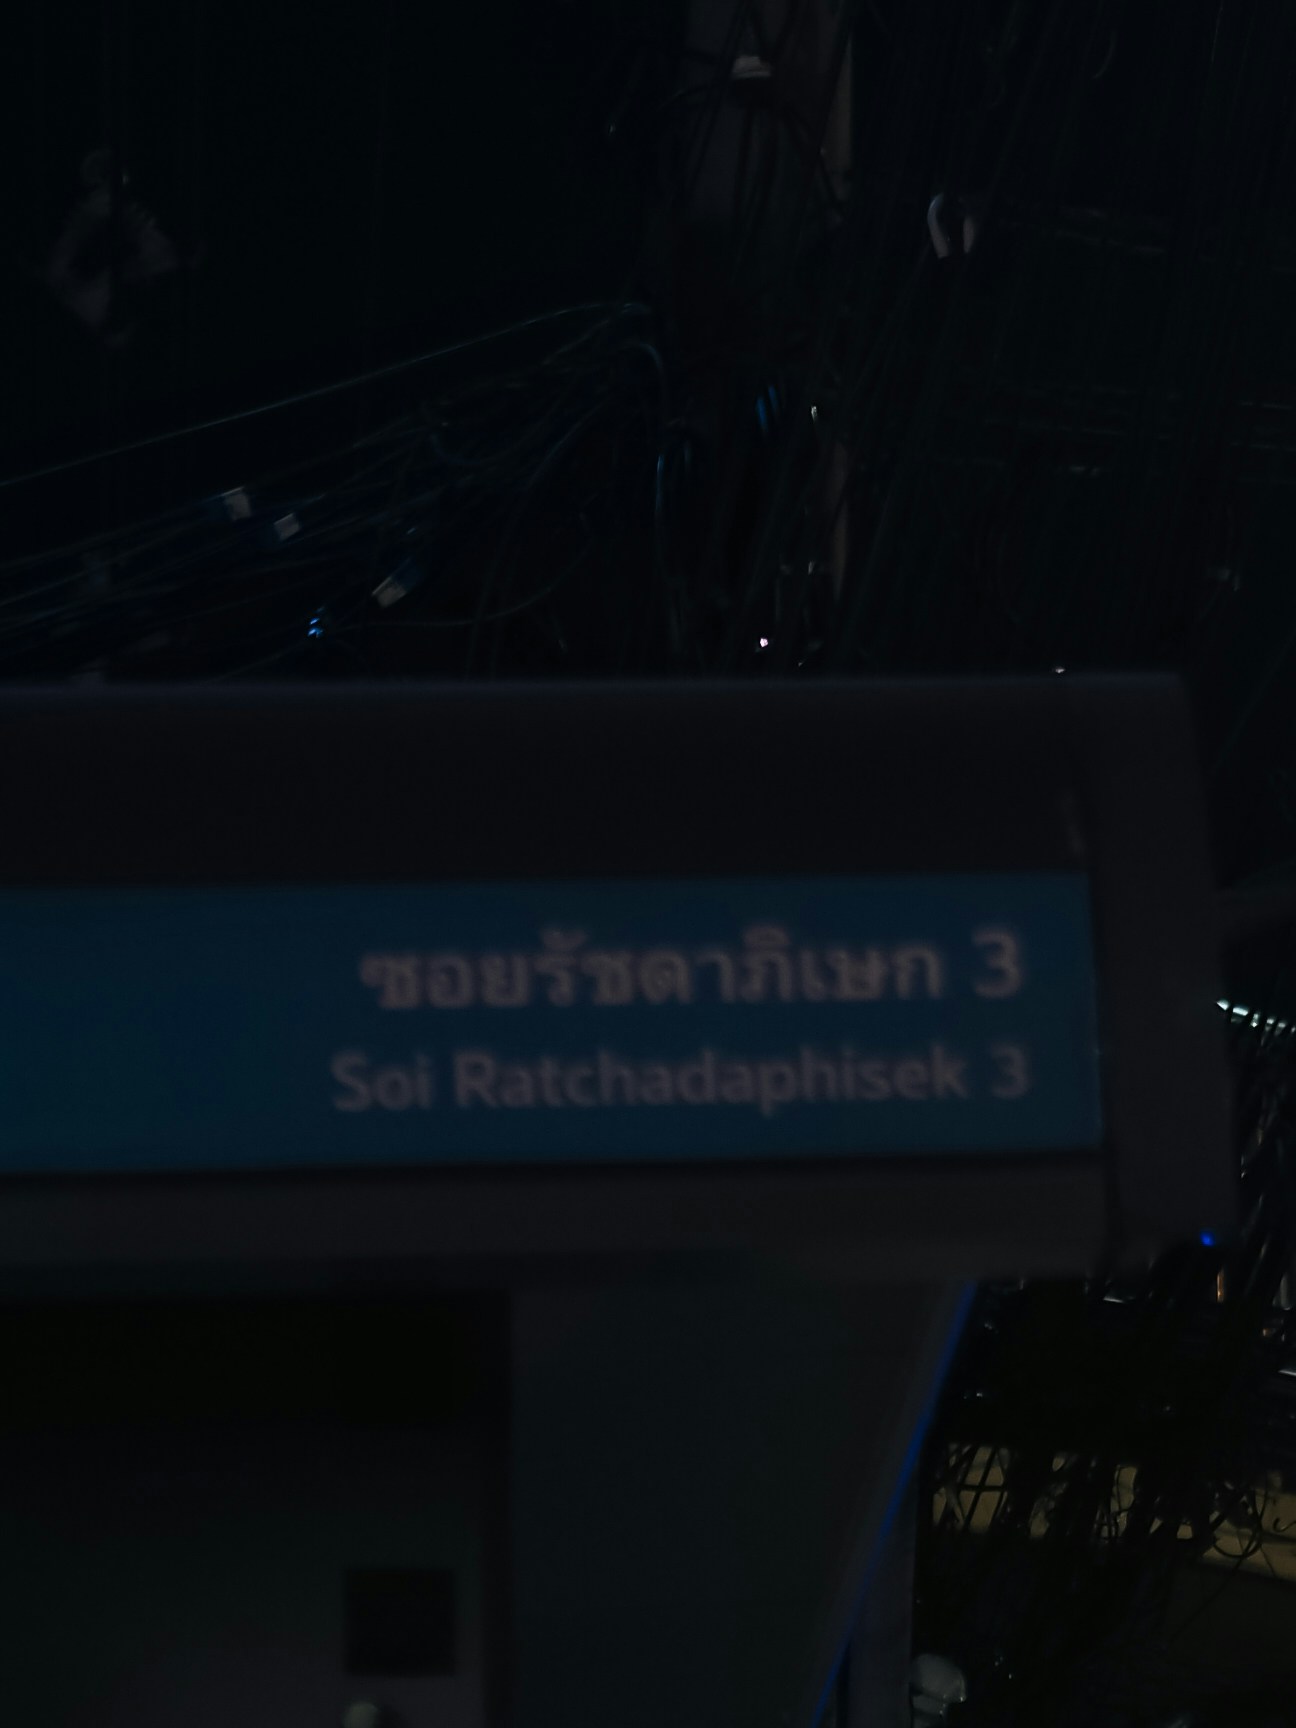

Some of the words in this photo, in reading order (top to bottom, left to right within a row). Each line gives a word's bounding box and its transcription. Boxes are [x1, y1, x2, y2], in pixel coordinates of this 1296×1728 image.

[358, 922, 944, 1010] ซอยรัชดาภิเษก
[972, 924, 1026, 999] 3
[330, 1047, 432, 1113] Soi
[454, 1043, 969, 1118] Ratchadaphisek
[993, 1047, 1031, 1100] 3
